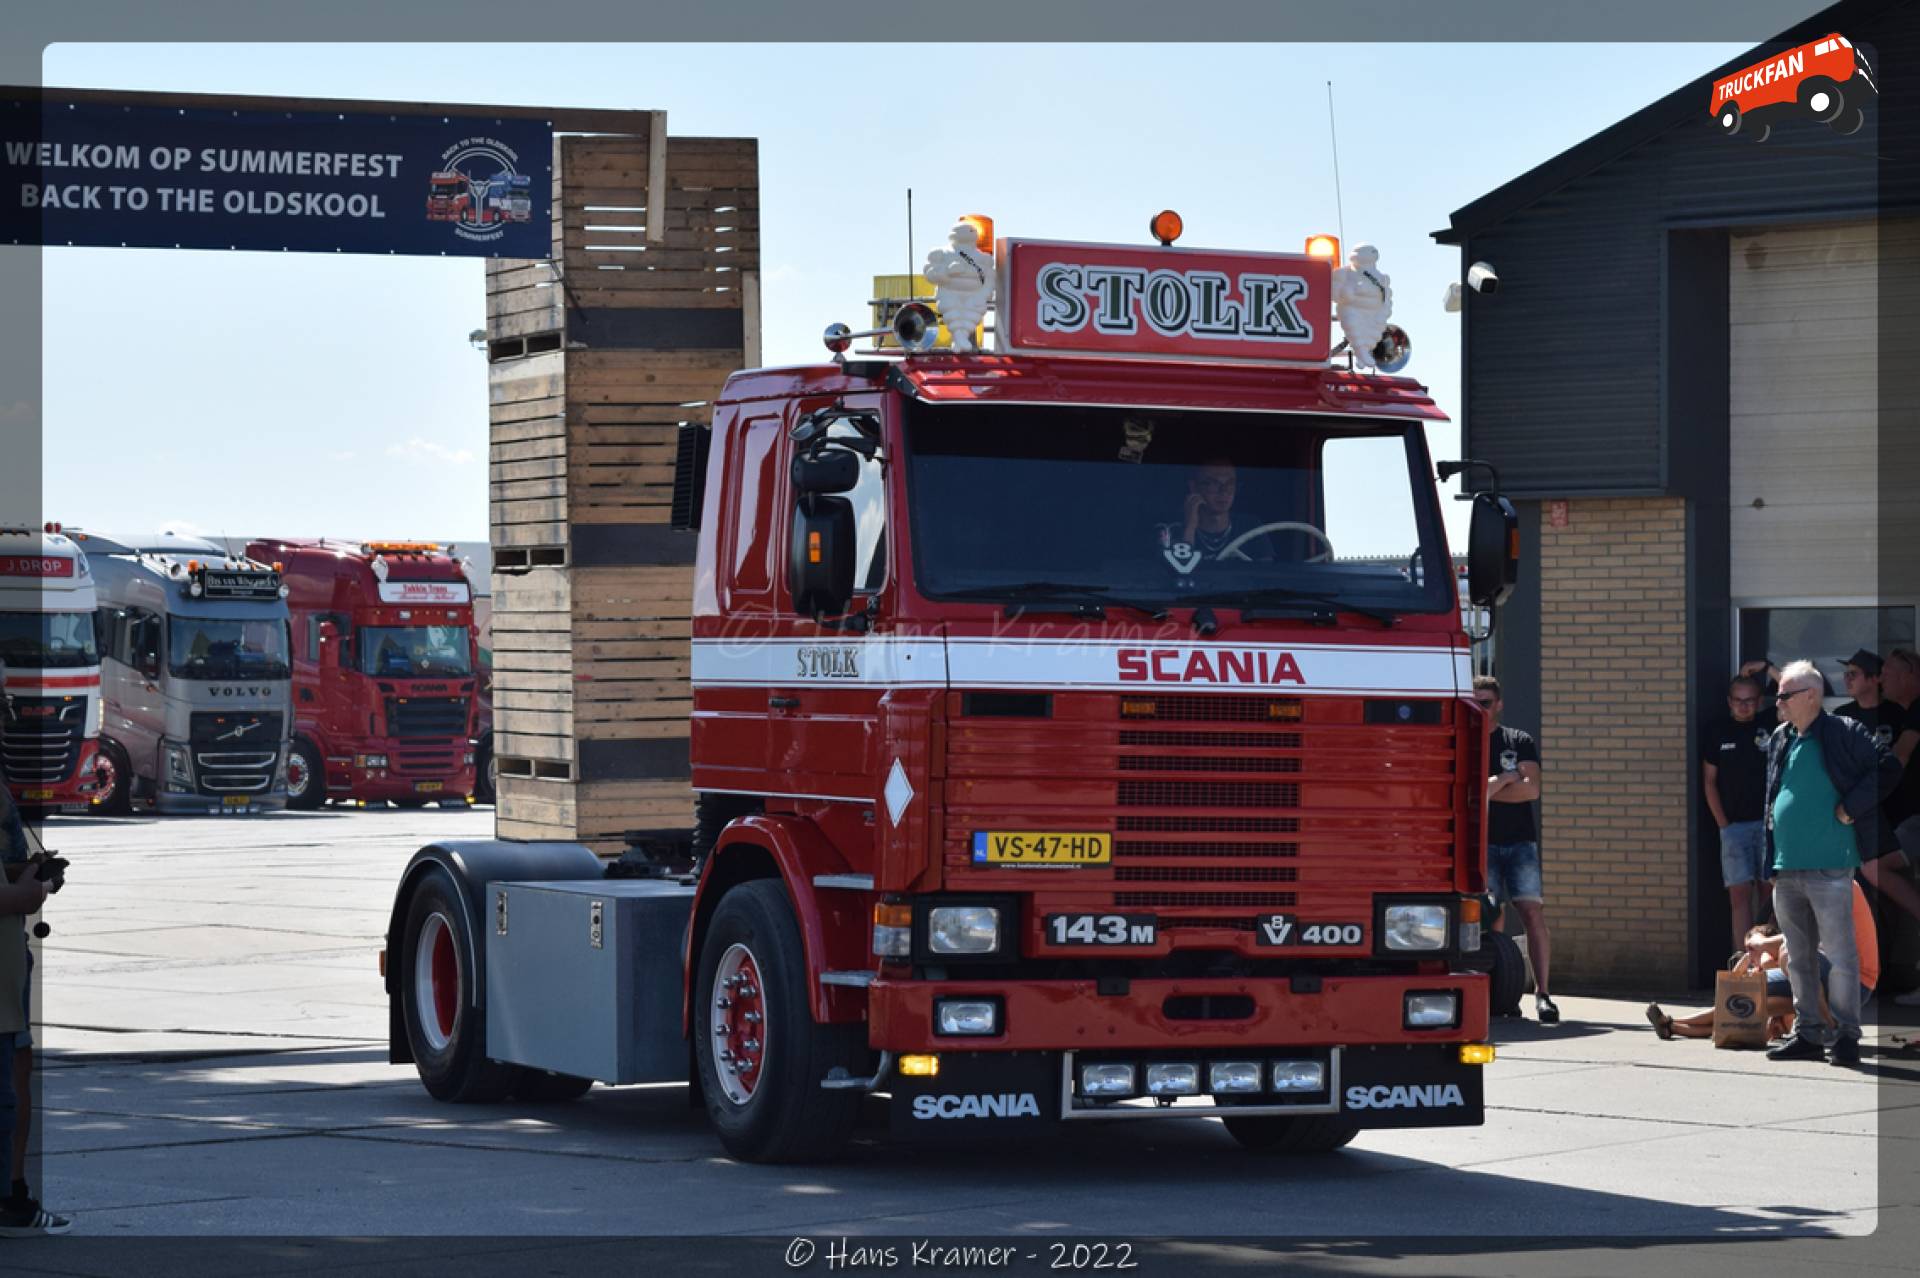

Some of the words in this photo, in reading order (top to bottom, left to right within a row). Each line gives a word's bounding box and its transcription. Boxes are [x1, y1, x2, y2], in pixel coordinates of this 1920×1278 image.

[6, 141, 140, 169] WELKOM
[149, 146, 193, 171] OP
[200, 148, 404, 178] SUMMERFEST
[21, 183, 102, 210] BACK
[109, 186, 149, 211] TO
[156, 187, 215, 213] THE
[223, 189, 386, 218] OLDSKOOL
[1037, 262, 1313, 344] STOLK
[797, 646, 859, 678] STOLK
[1117, 649, 1306, 685] SCANIA
[208, 686, 272, 697] VOLVO
[994, 836, 1103, 859] VS-47-HD
[1302, 924, 1362, 944] 400
[912, 1092, 1040, 1120] SCANIA
[1345, 1084, 1465, 1110] SCANIA
